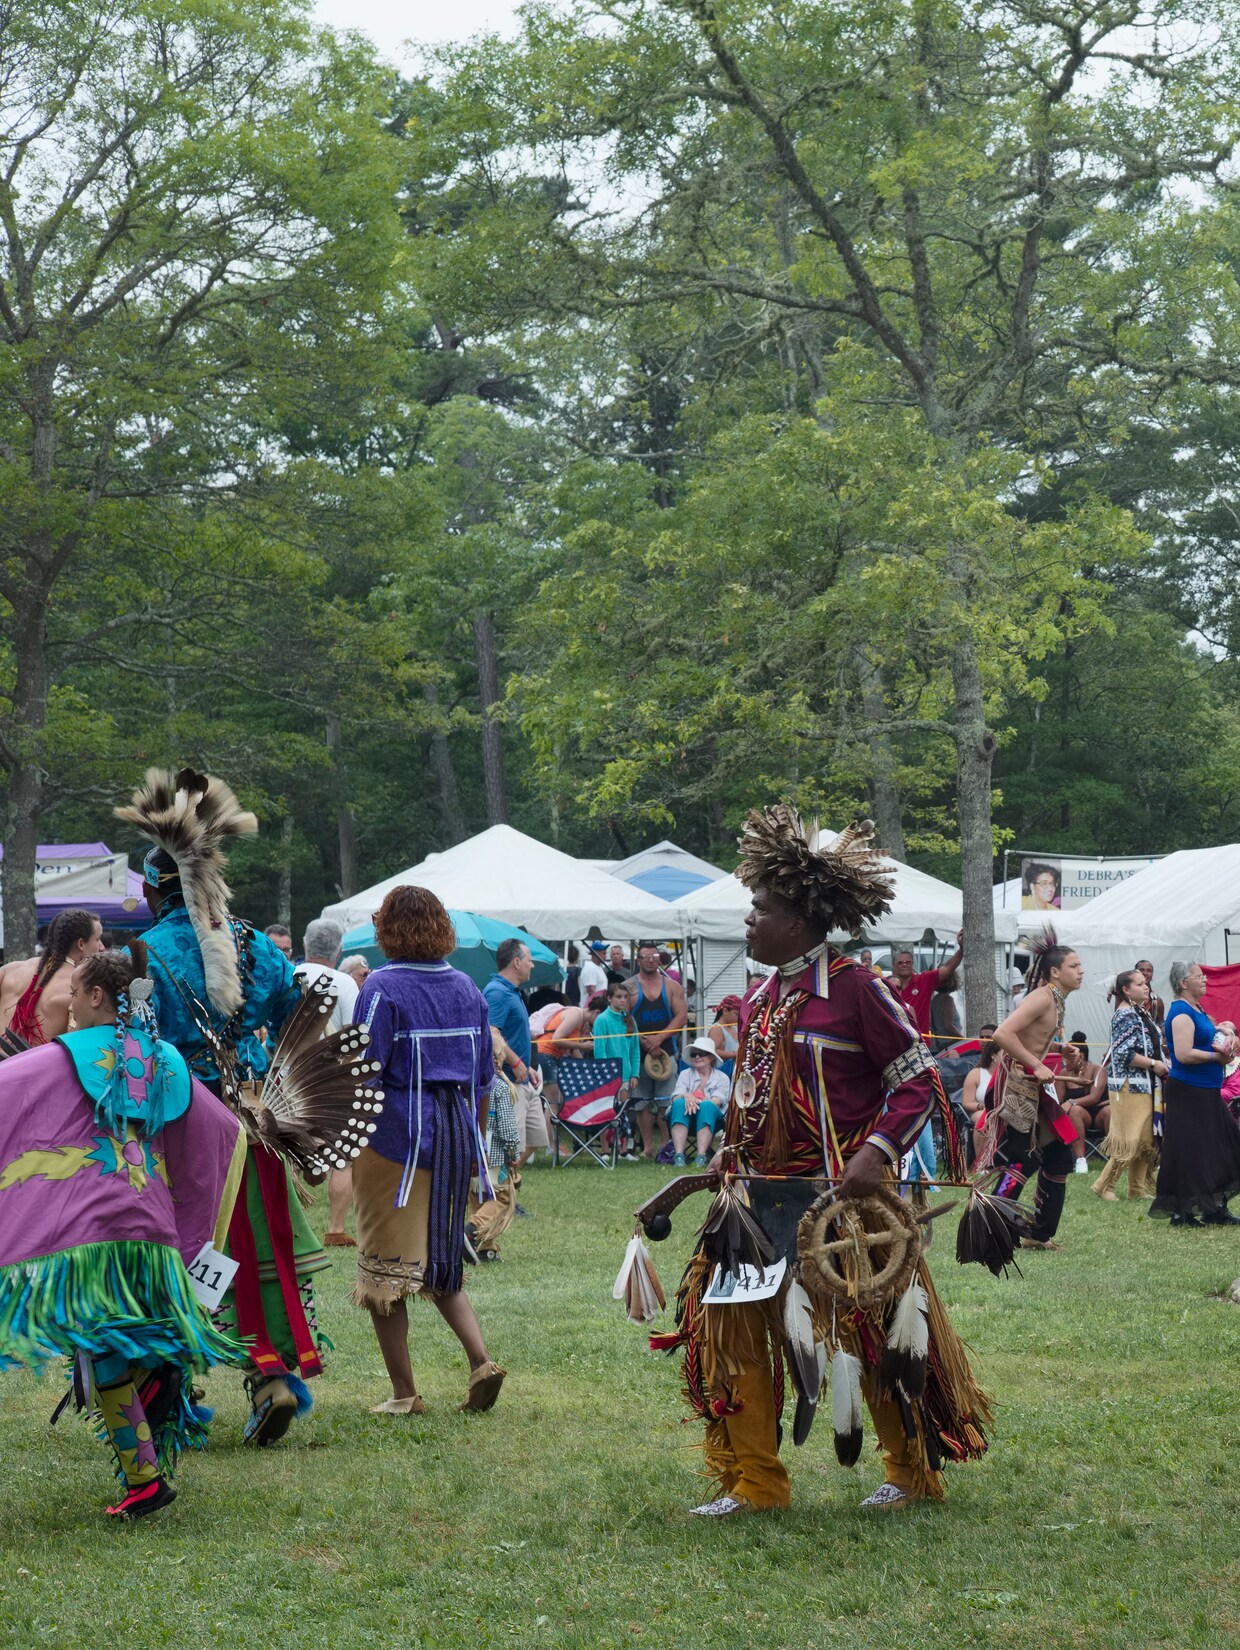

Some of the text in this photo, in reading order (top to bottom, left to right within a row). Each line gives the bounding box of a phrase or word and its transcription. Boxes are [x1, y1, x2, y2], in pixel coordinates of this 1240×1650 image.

[1077, 869, 1135, 881] DEBRA'S
[1062, 886, 1102, 898] FRIED
[737, 1274, 777, 1291] 411
